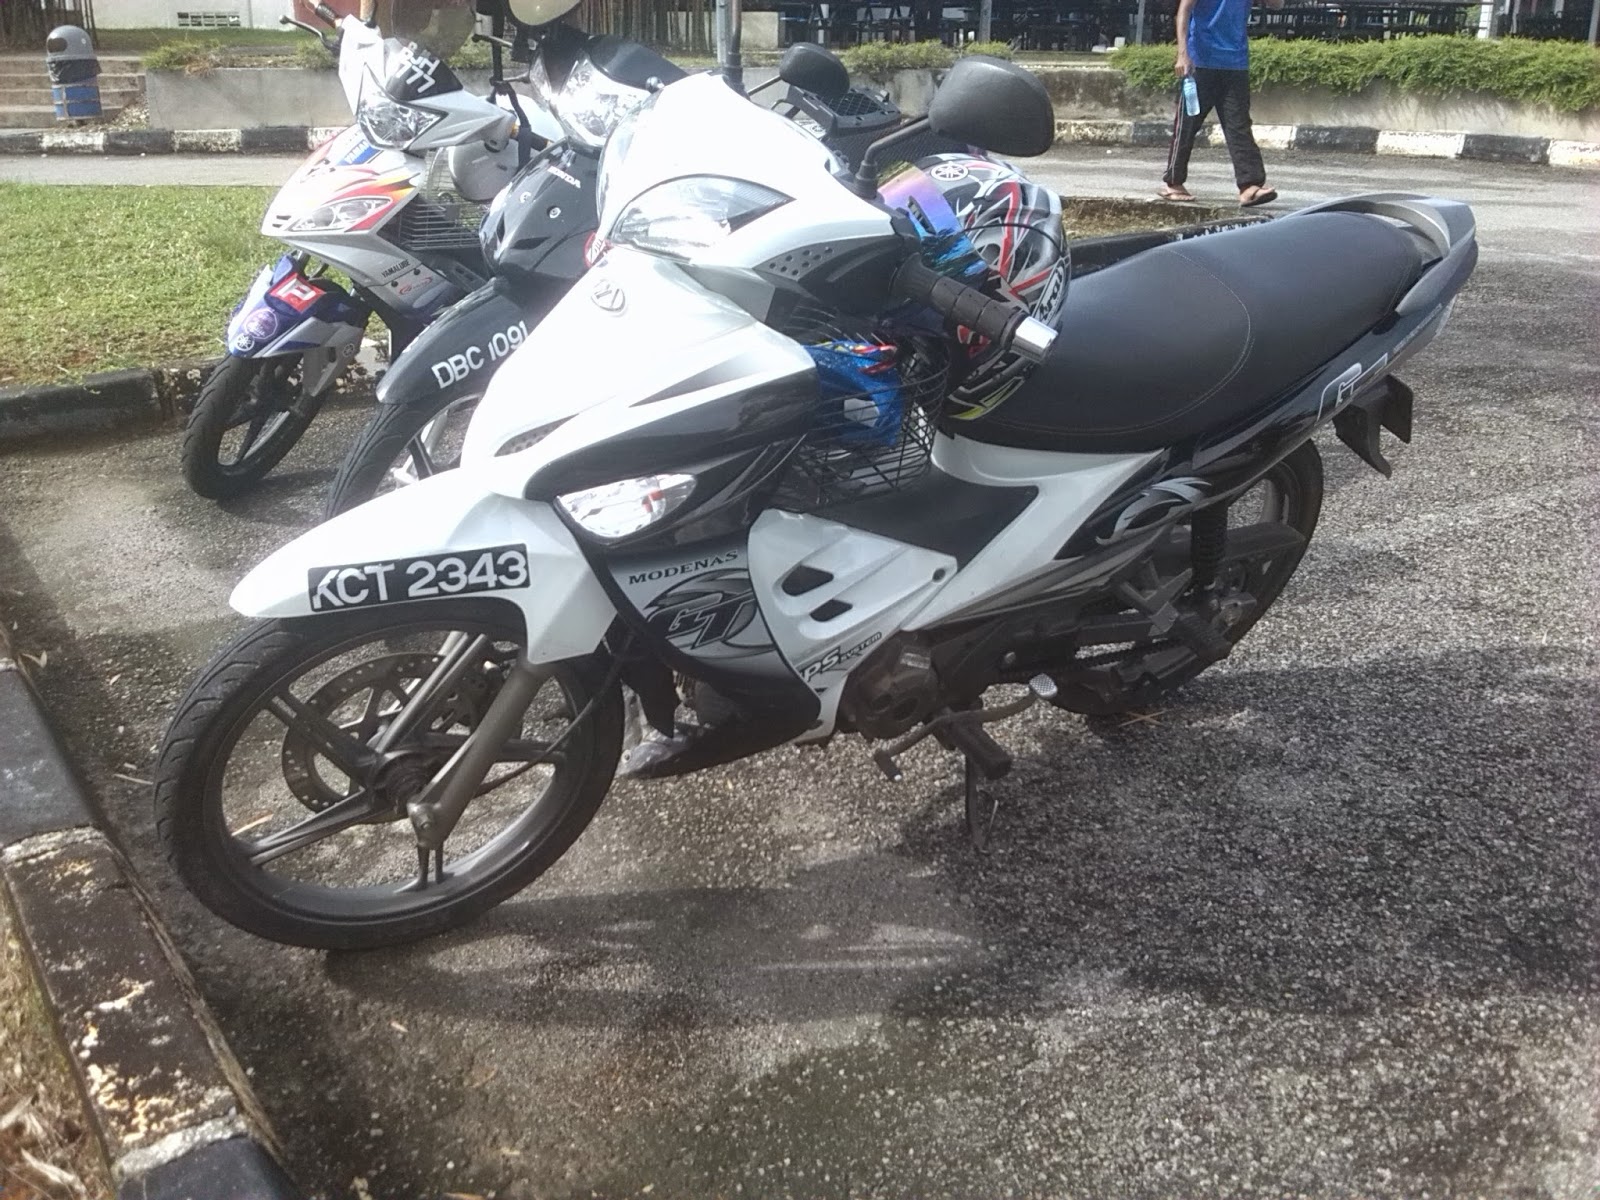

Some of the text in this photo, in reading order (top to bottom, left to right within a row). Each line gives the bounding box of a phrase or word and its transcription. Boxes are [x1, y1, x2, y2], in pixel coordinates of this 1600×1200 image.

[546, 165, 581, 189] HONDA
[381, 259, 411, 278] YAMALUBE
[276, 278, 317, 301] P
[431, 320, 529, 389] DBC 1091
[312, 550, 528, 610] KCT 2343
[628, 550, 739, 585] MODENAS
